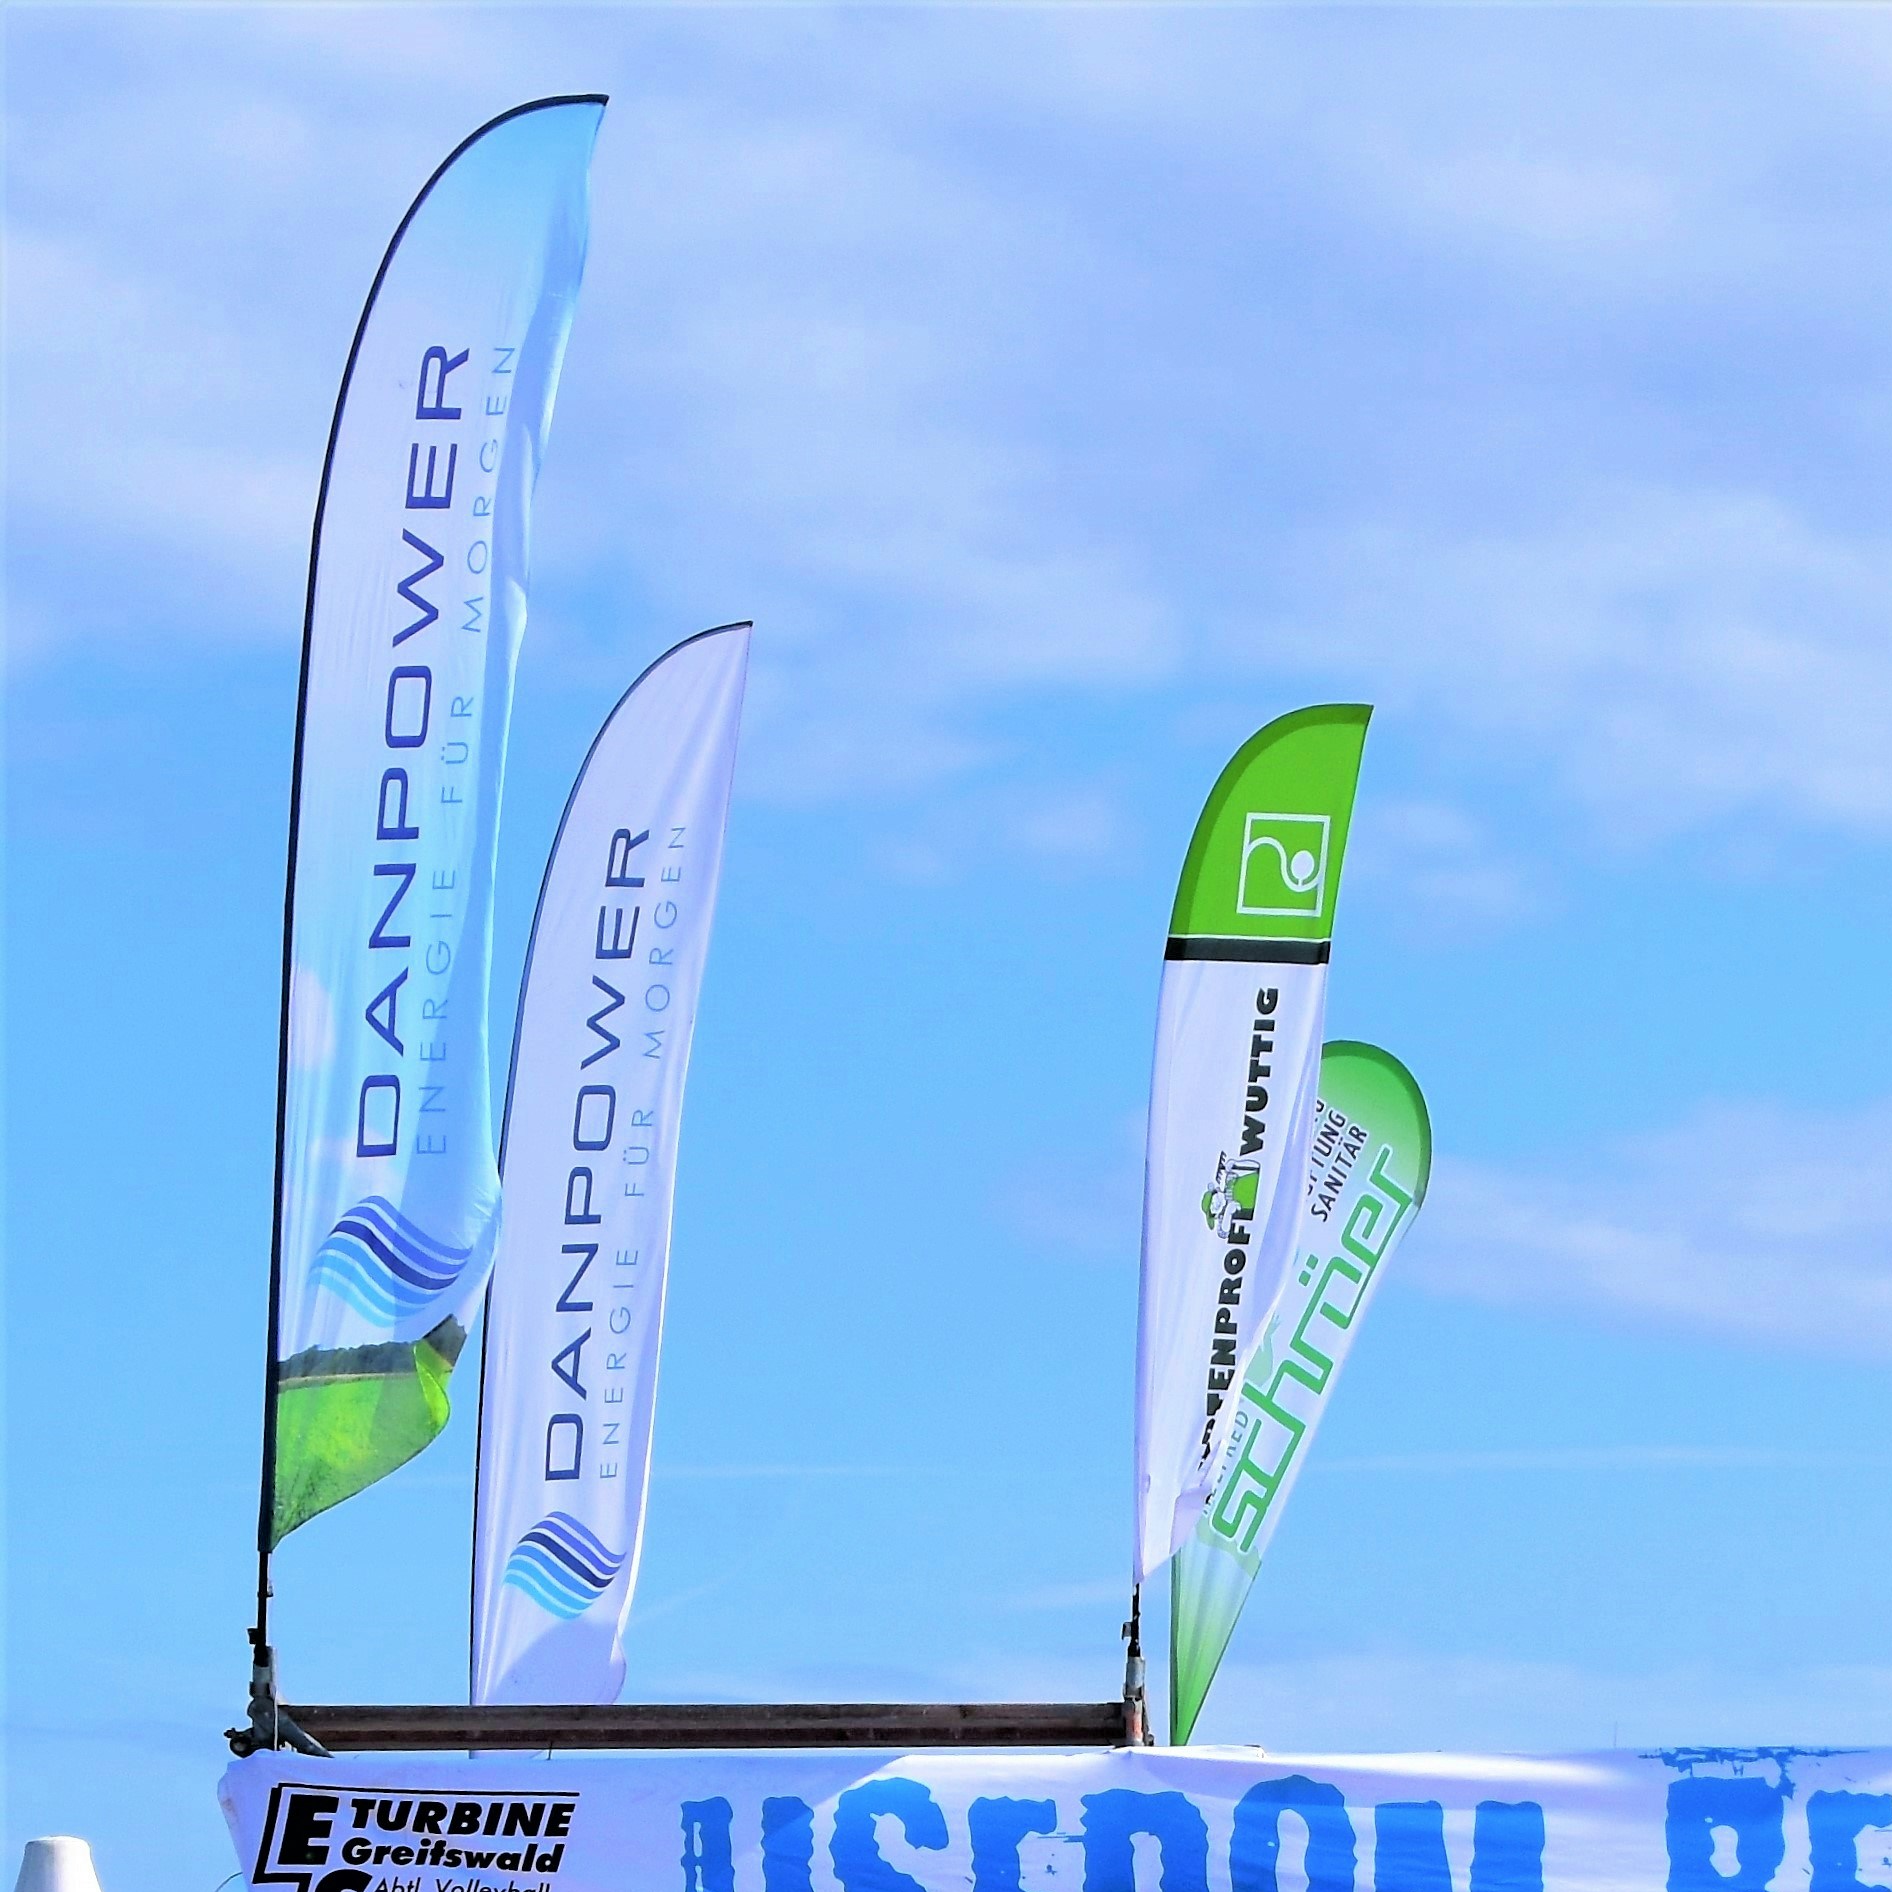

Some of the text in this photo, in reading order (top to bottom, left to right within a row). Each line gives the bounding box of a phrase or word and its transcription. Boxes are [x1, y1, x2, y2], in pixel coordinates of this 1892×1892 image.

[356, 344, 470, 1157] DANPOWER
[415, 346, 516, 1155] ENERGIE FÜR MORGEN
[544, 827, 650, 1481] DANPOWER
[600, 826, 686, 1480] ENERGIE FÜR MORGEN
[1239, 987, 1279, 1155] WUTTIG
[1310, 1125, 1367, 1222] SANITÄR
[341, 1836, 566, 1873] Greifswald
[350, 1798, 575, 1837] TURBINE
